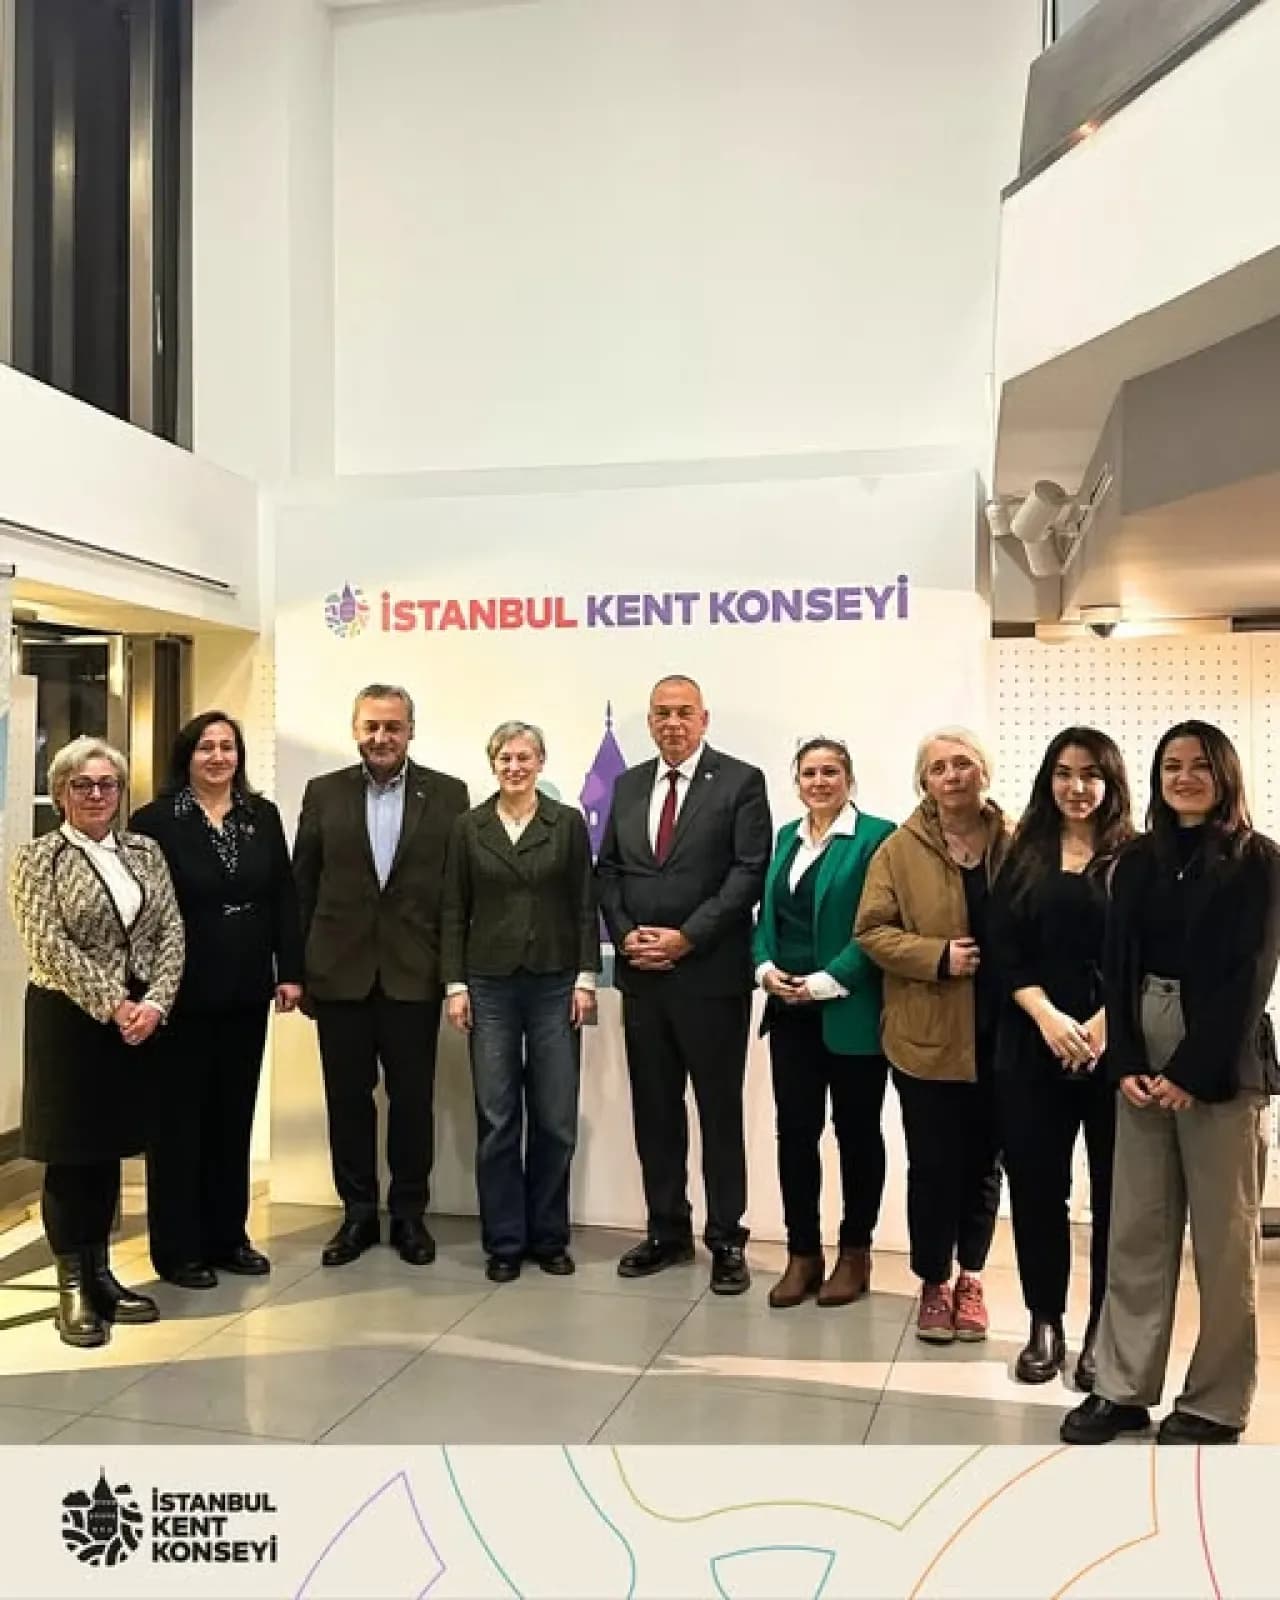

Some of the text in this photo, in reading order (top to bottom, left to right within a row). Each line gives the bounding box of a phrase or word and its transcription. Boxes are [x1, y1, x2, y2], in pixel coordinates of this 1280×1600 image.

[380, 574, 909, 632] İSTANBUL KENT KONSEYİ
